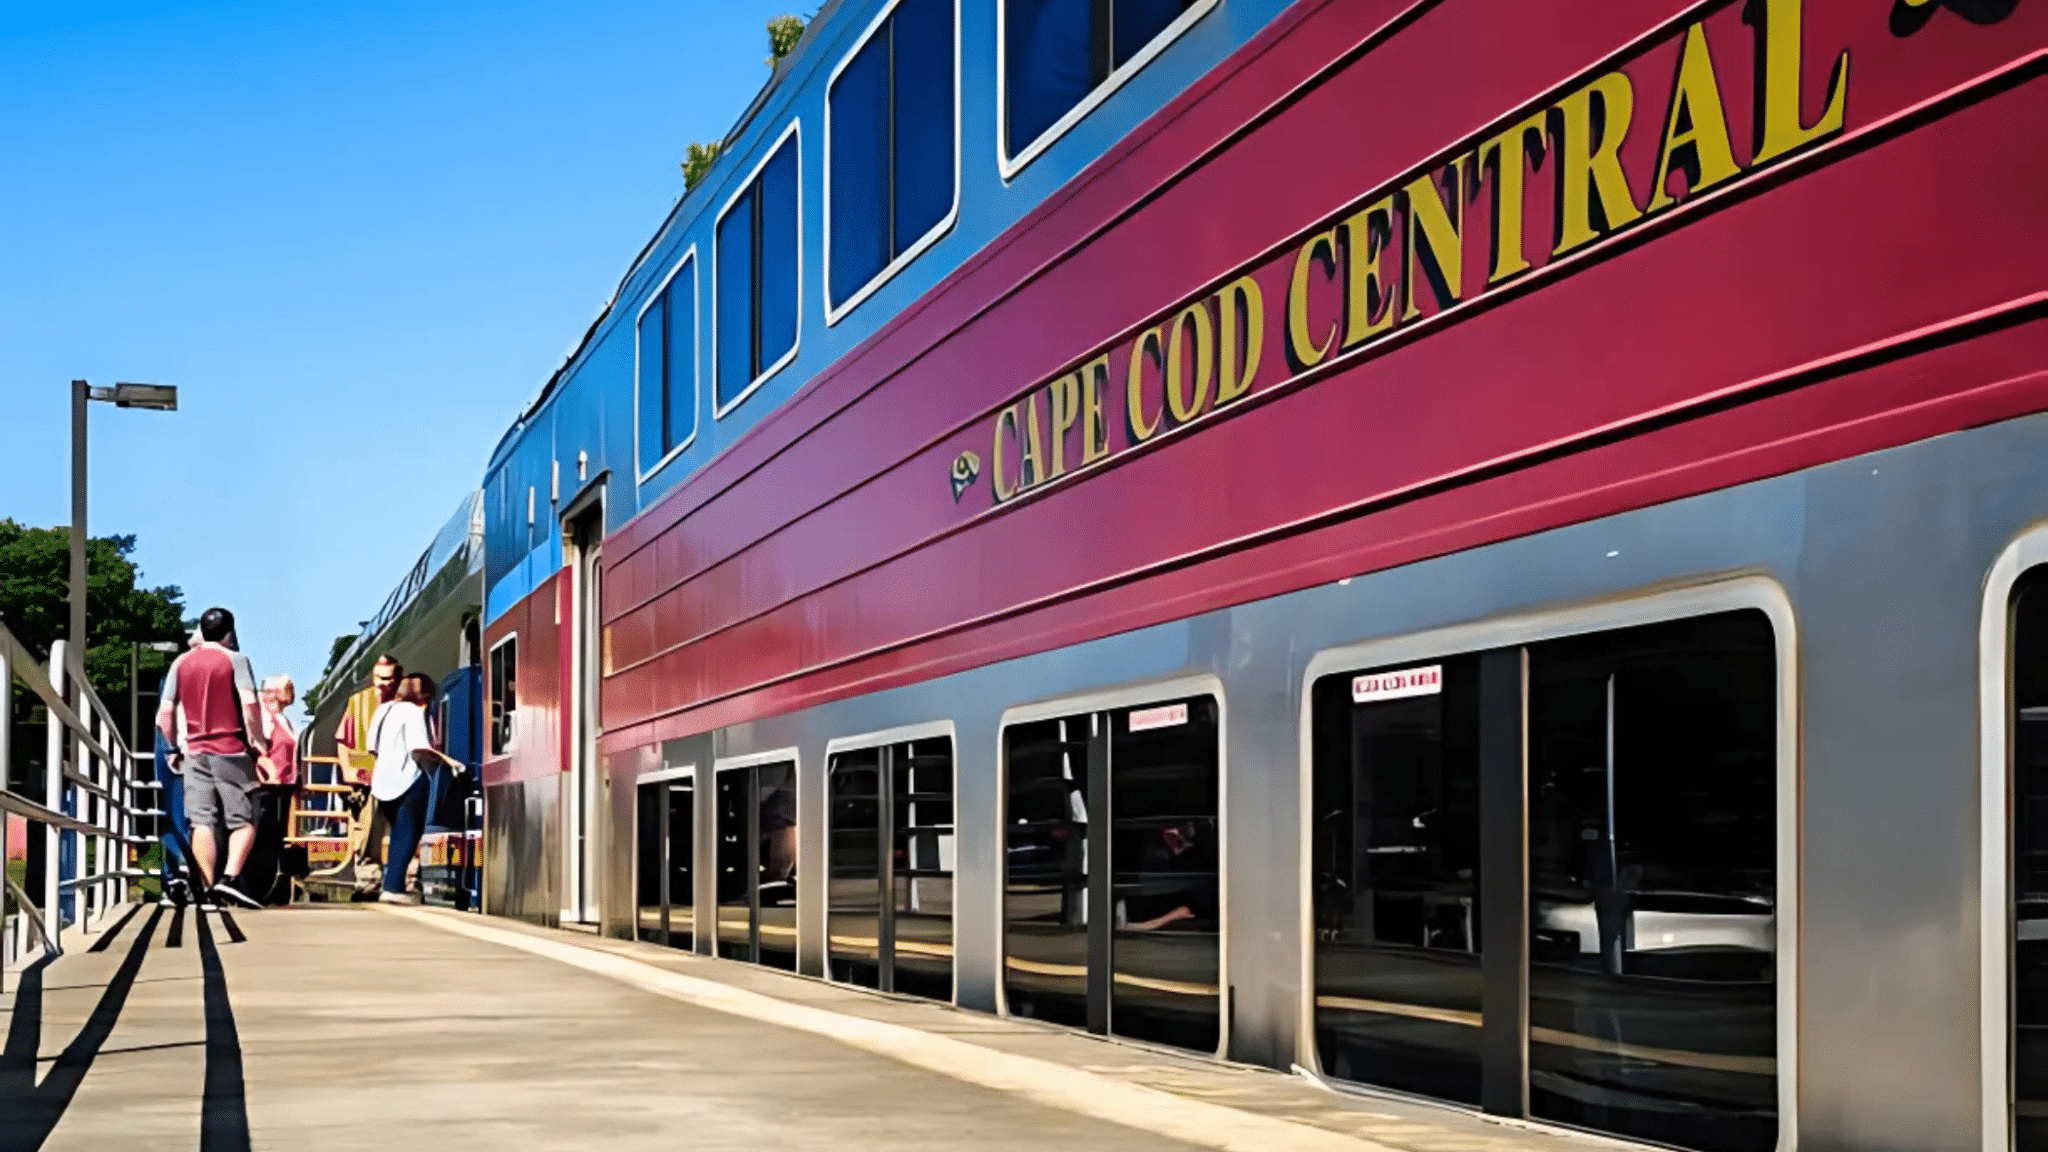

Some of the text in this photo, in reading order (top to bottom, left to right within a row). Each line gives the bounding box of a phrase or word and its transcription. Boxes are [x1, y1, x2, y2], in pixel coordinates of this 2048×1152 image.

[992, 0, 1850, 503] CAPE COD CENTRAL
